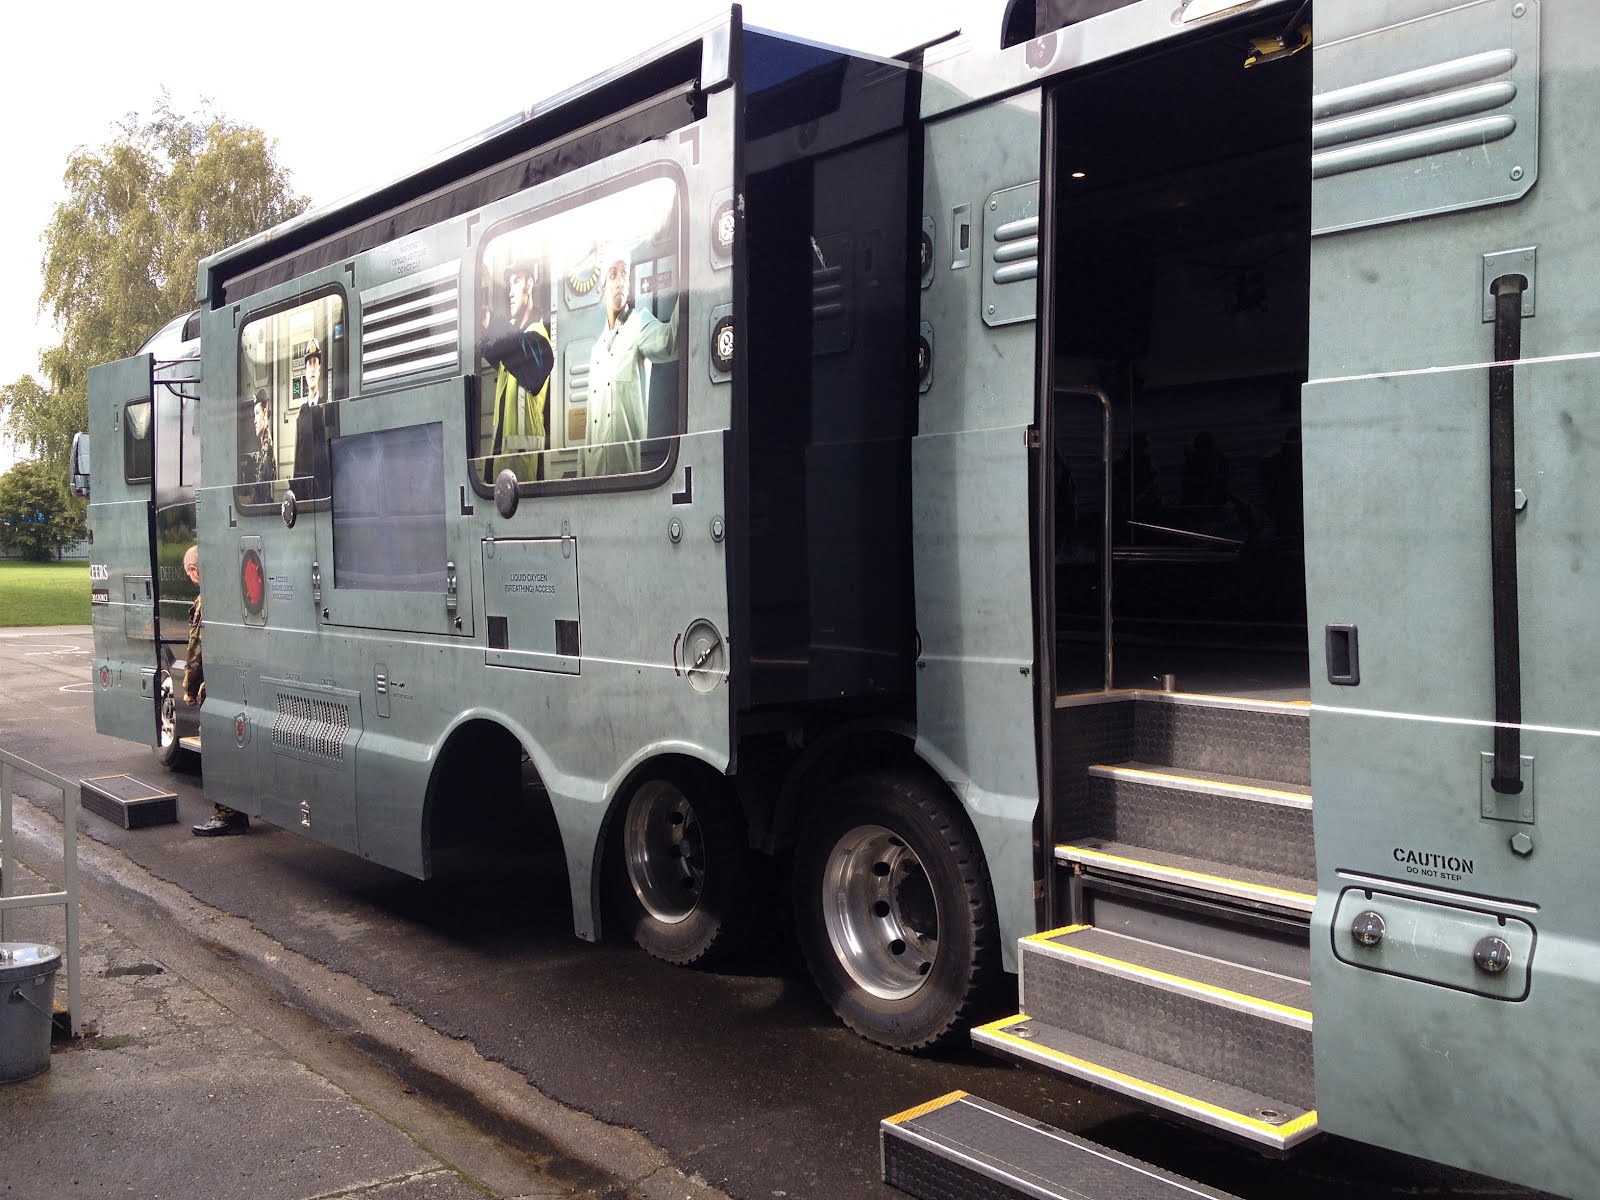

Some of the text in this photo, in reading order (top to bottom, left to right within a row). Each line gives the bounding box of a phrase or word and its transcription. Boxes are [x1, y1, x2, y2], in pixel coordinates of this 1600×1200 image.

[510, 573, 548, 582] LIQUID OXYGEN
[535, 584, 556, 594] ACCESS
[1393, 848, 1474, 874] CAUTION
[1406, 866, 1462, 881] DO NOT STEP
